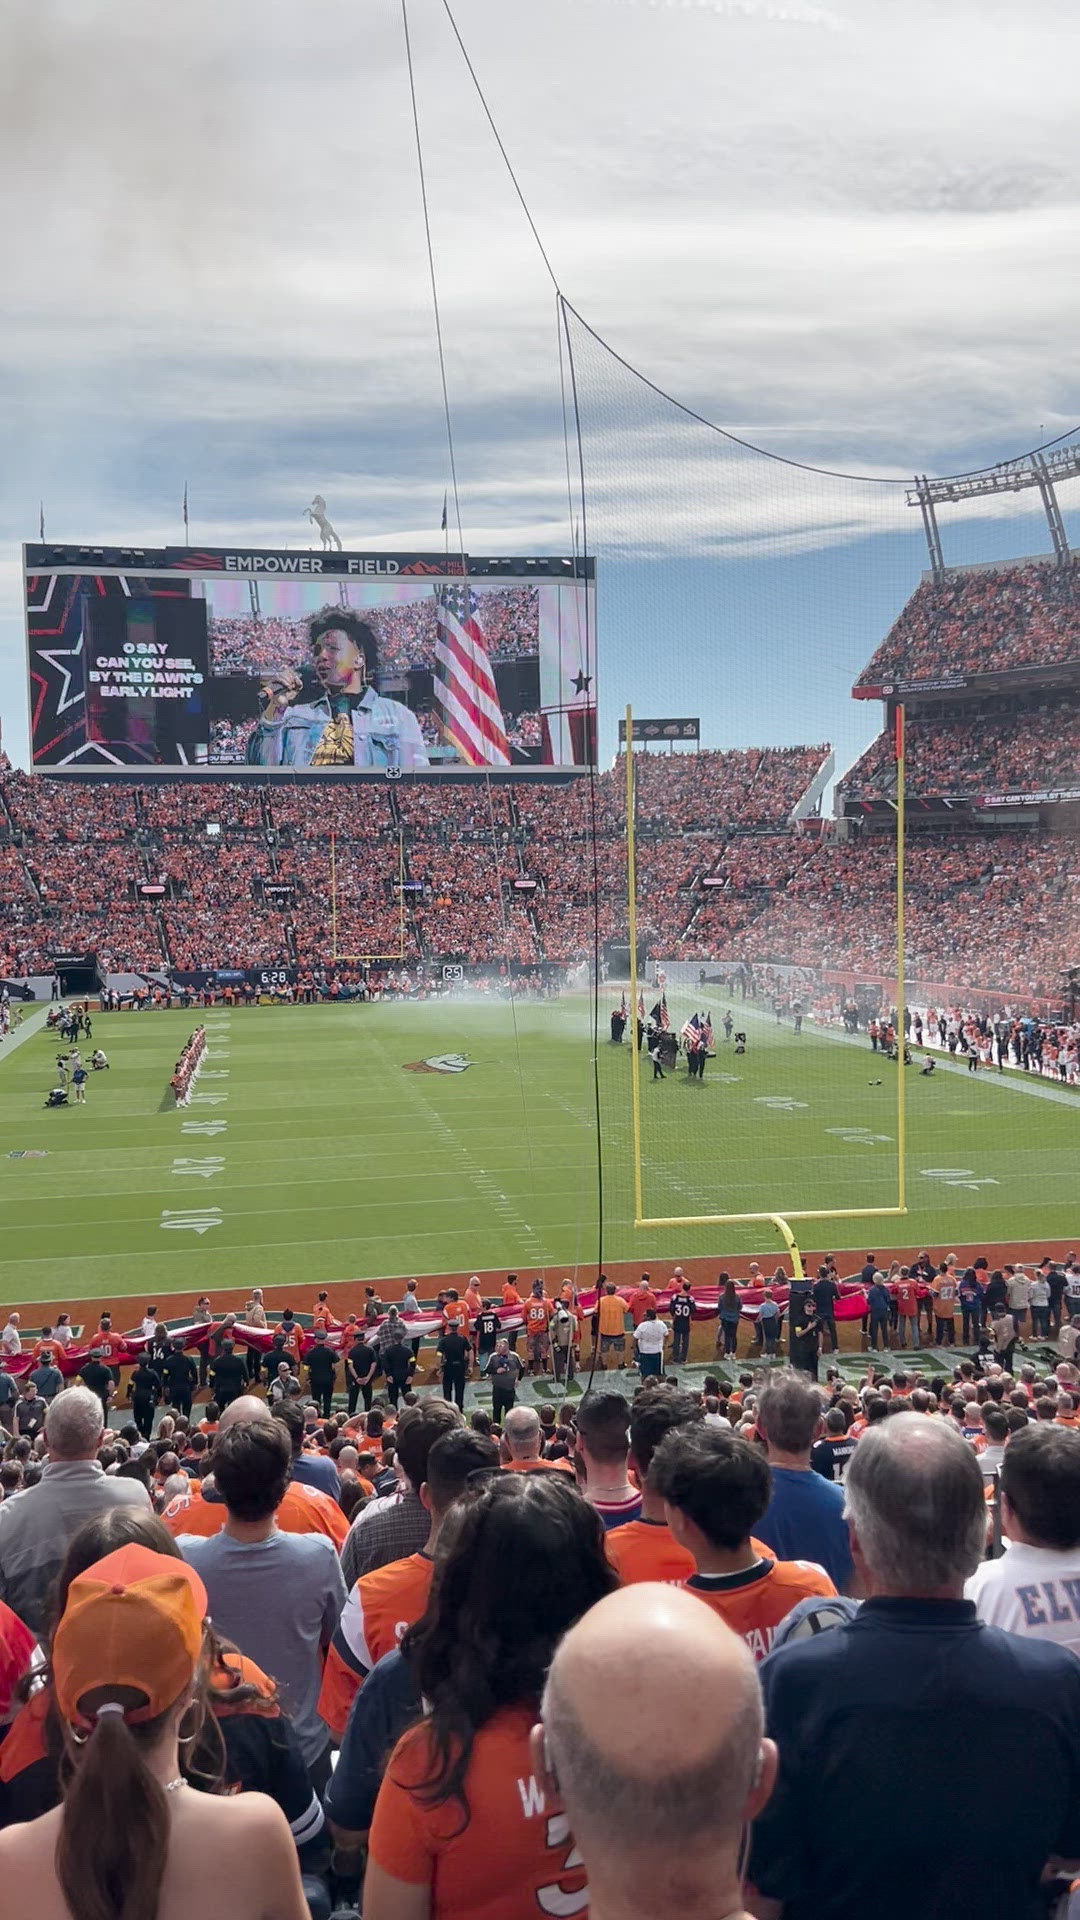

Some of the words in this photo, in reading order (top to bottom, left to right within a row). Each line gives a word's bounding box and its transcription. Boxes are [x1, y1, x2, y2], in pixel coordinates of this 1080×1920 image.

[225, 556, 323, 573] EMPOWER
[347, 558, 400, 575] FIELD
[123, 642, 135, 654] O
[136, 643, 168, 654] SAY
[96, 657, 129, 668] CAN
[131, 658, 163, 669] YOU
[165, 658, 196, 671] SEE,
[89, 671, 110, 682] BY
[113, 672, 142, 683] THE
[143, 672, 204, 684] DAWN'S
[100, 686, 149, 697] EARLY
[151, 687, 194, 698] LIGHT
[261, 972, 286, 983] 6:28
[446, 967, 460, 978] 25
[160, 1207, 223, 1235] 10
[902, 1288, 910, 1300] 2
[529, 1307, 545, 1320] 88
[675, 1304, 690, 1317] 30
[483, 1320, 494, 1334] 18
